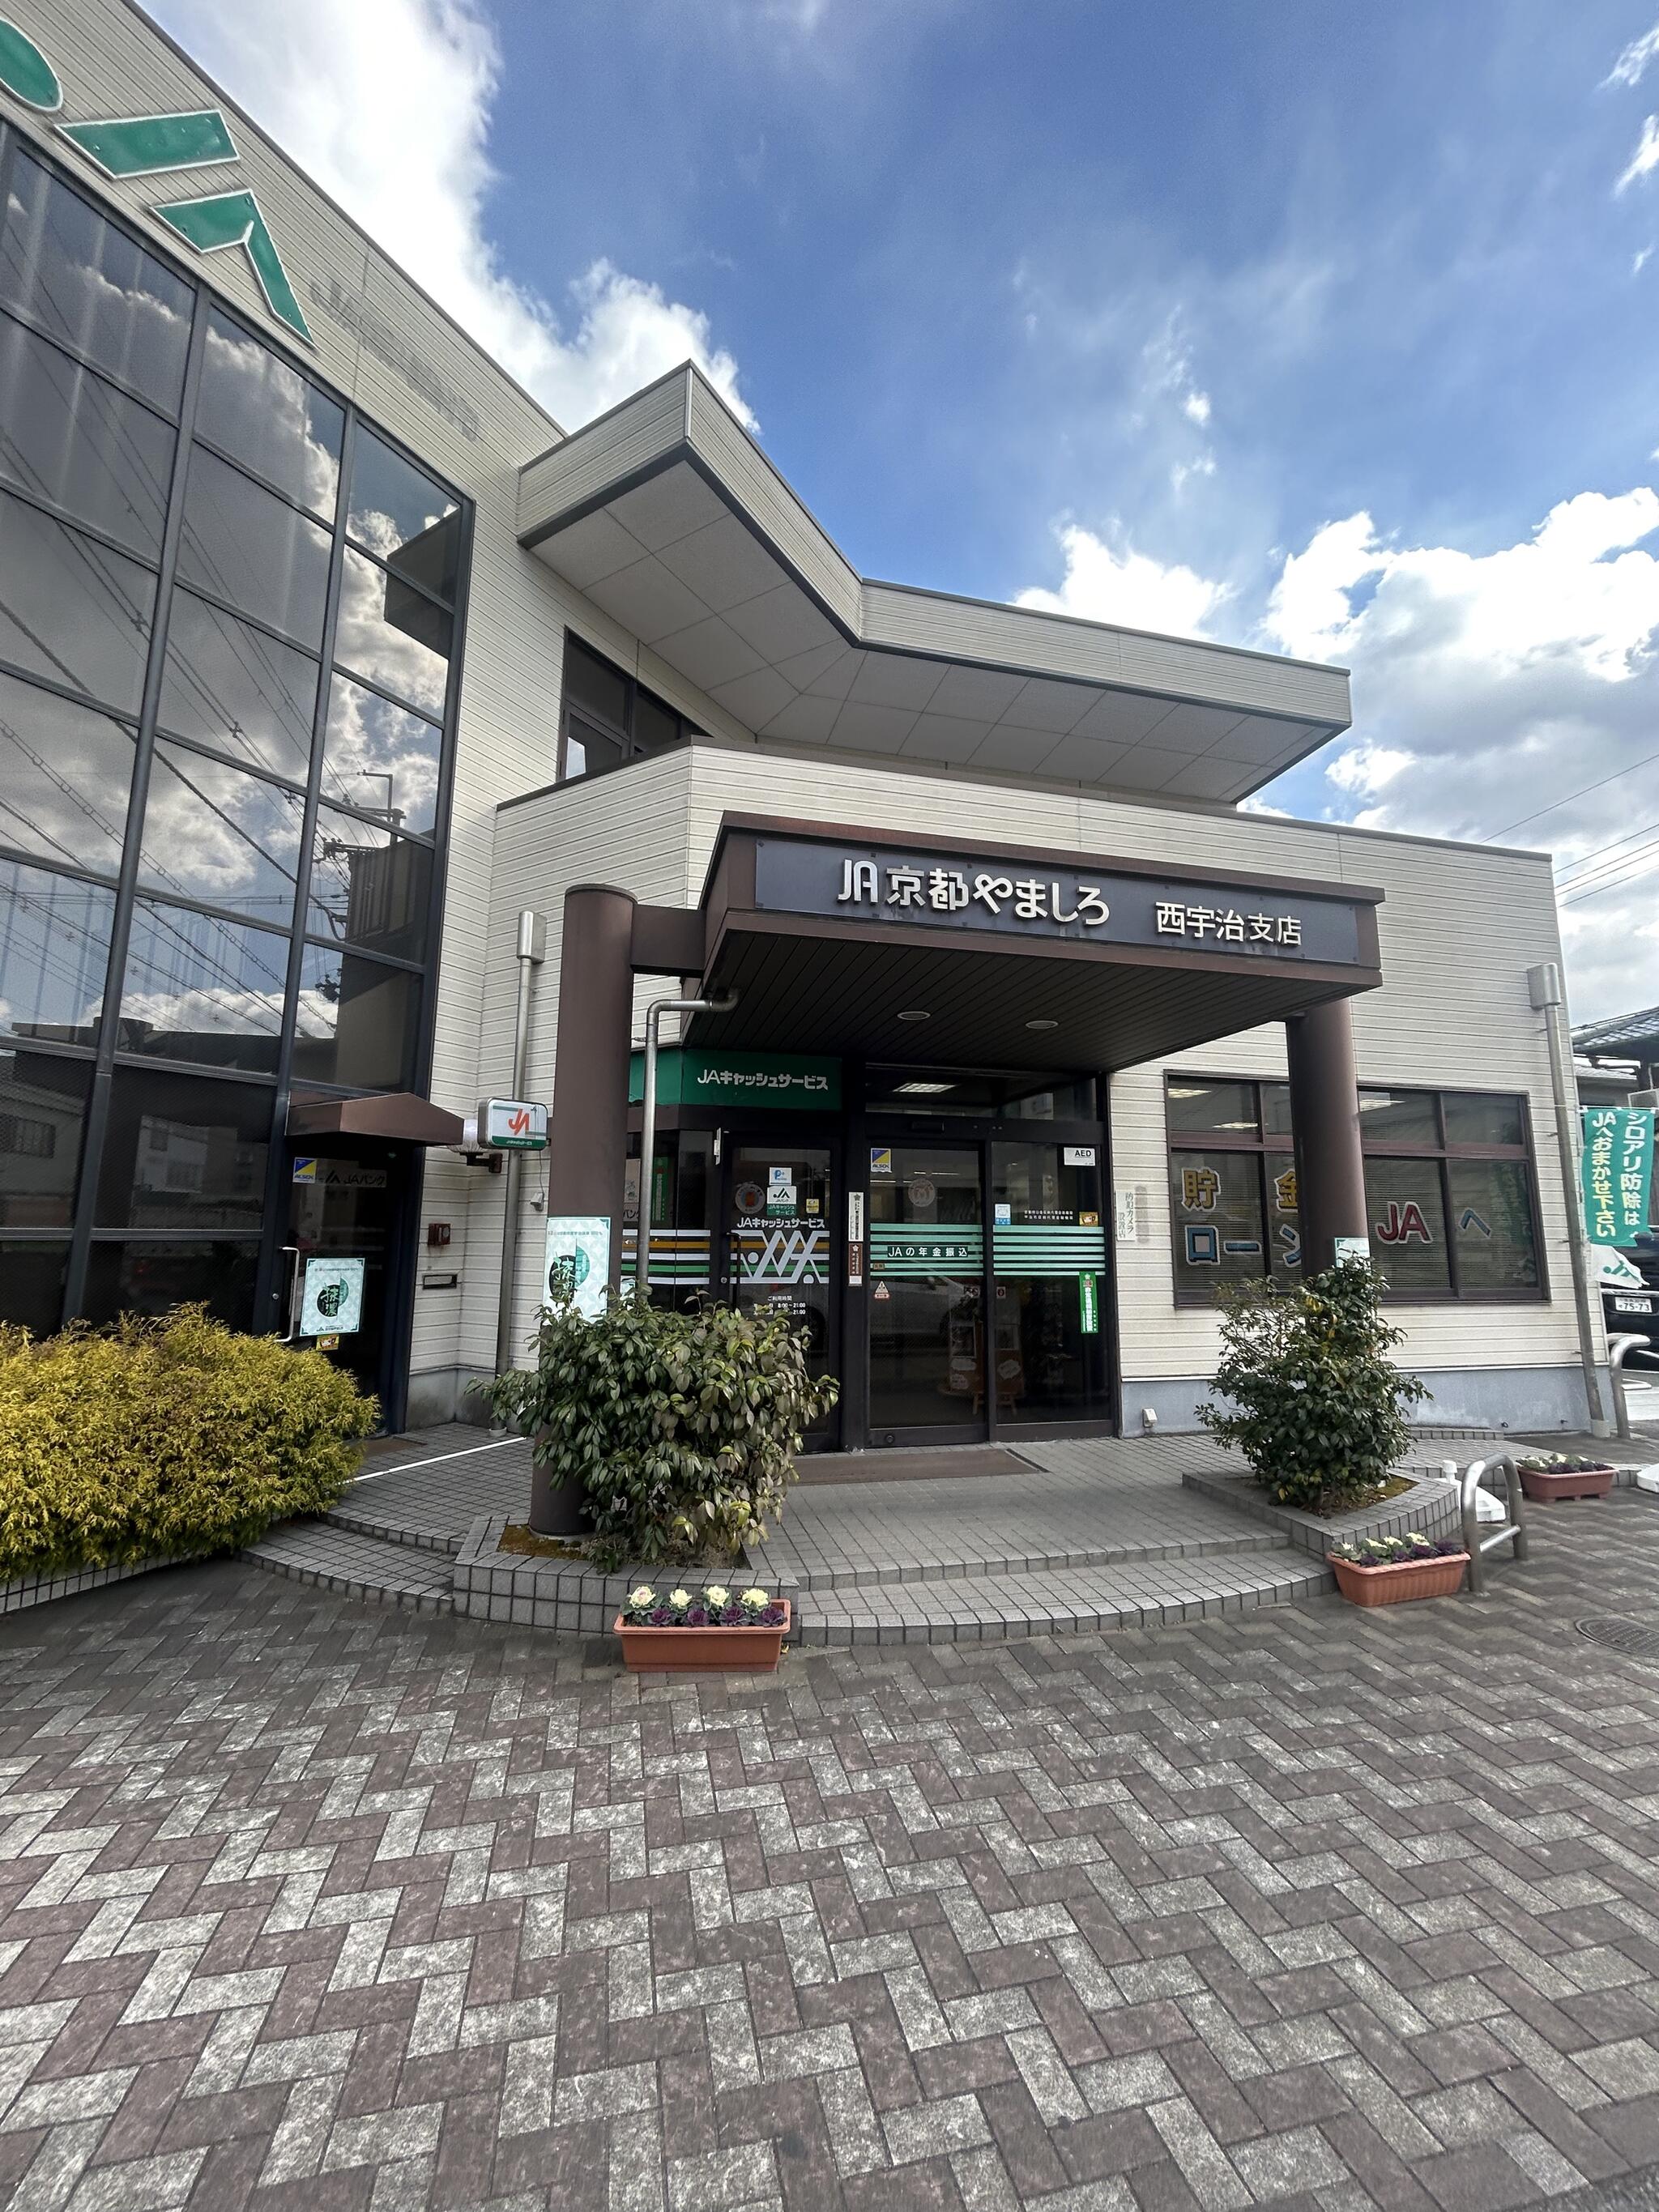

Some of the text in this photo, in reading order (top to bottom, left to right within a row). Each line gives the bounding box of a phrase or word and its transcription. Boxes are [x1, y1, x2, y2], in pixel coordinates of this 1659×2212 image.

[838, 857, 1303, 946] JA京都やましろ 西宇治支店
[697, 1068, 829, 1091] JAキャッシュサービス
[1592, 1112, 1617, 1238] JAへおまかせ下さい
[736, 1217, 825, 1229] JAキャッシュサービス
[888, 1245, 969, 1258] JAの年金振込
